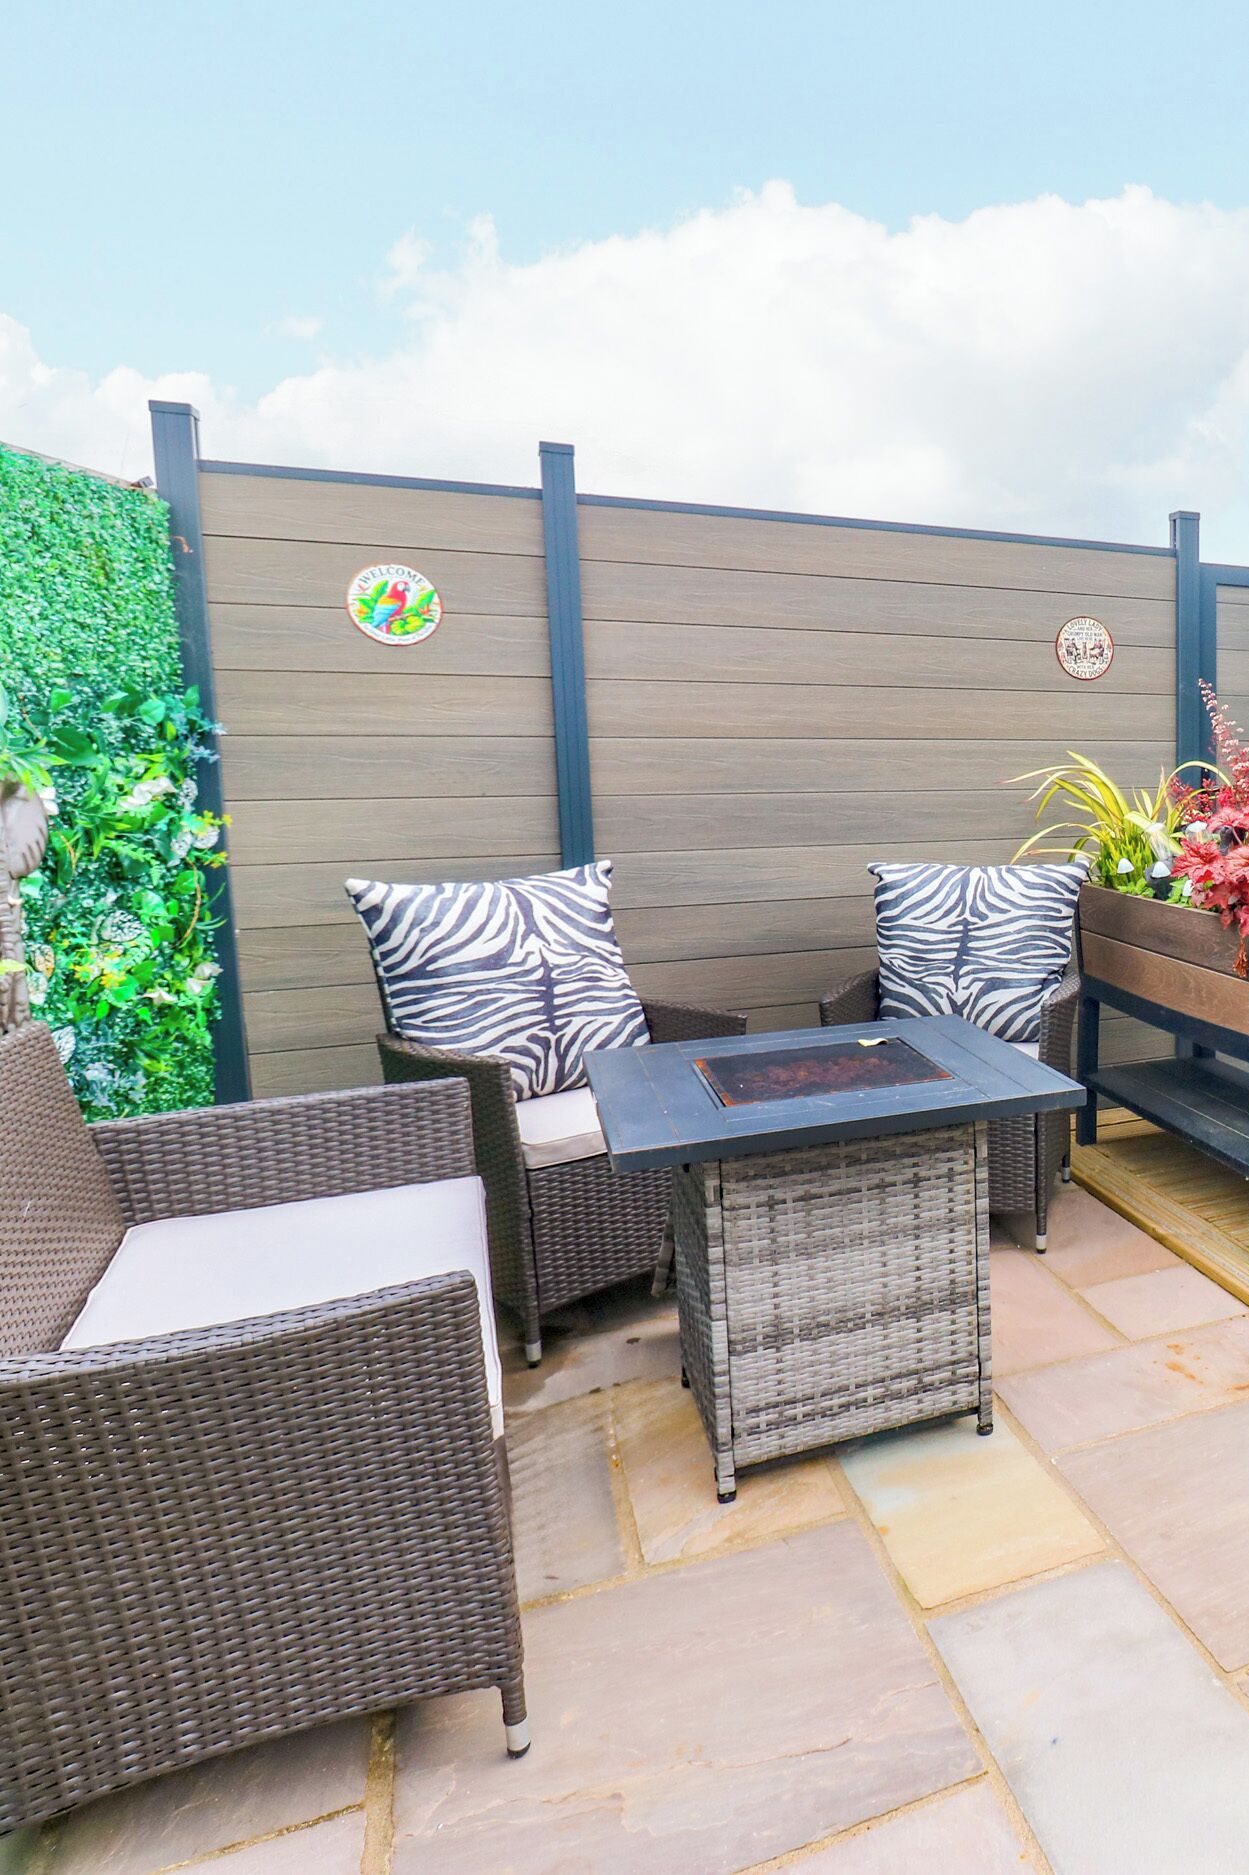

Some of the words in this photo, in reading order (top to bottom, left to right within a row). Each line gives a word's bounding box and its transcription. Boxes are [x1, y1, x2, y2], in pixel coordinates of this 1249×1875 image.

[358, 566, 426, 586] WELCOME
[1067, 619, 1087, 630] LOVELY
[1088, 620, 1103, 632] LADY
[1068, 666, 1087, 677] CRAZY
[1088, 667, 1103, 677] DOGS
